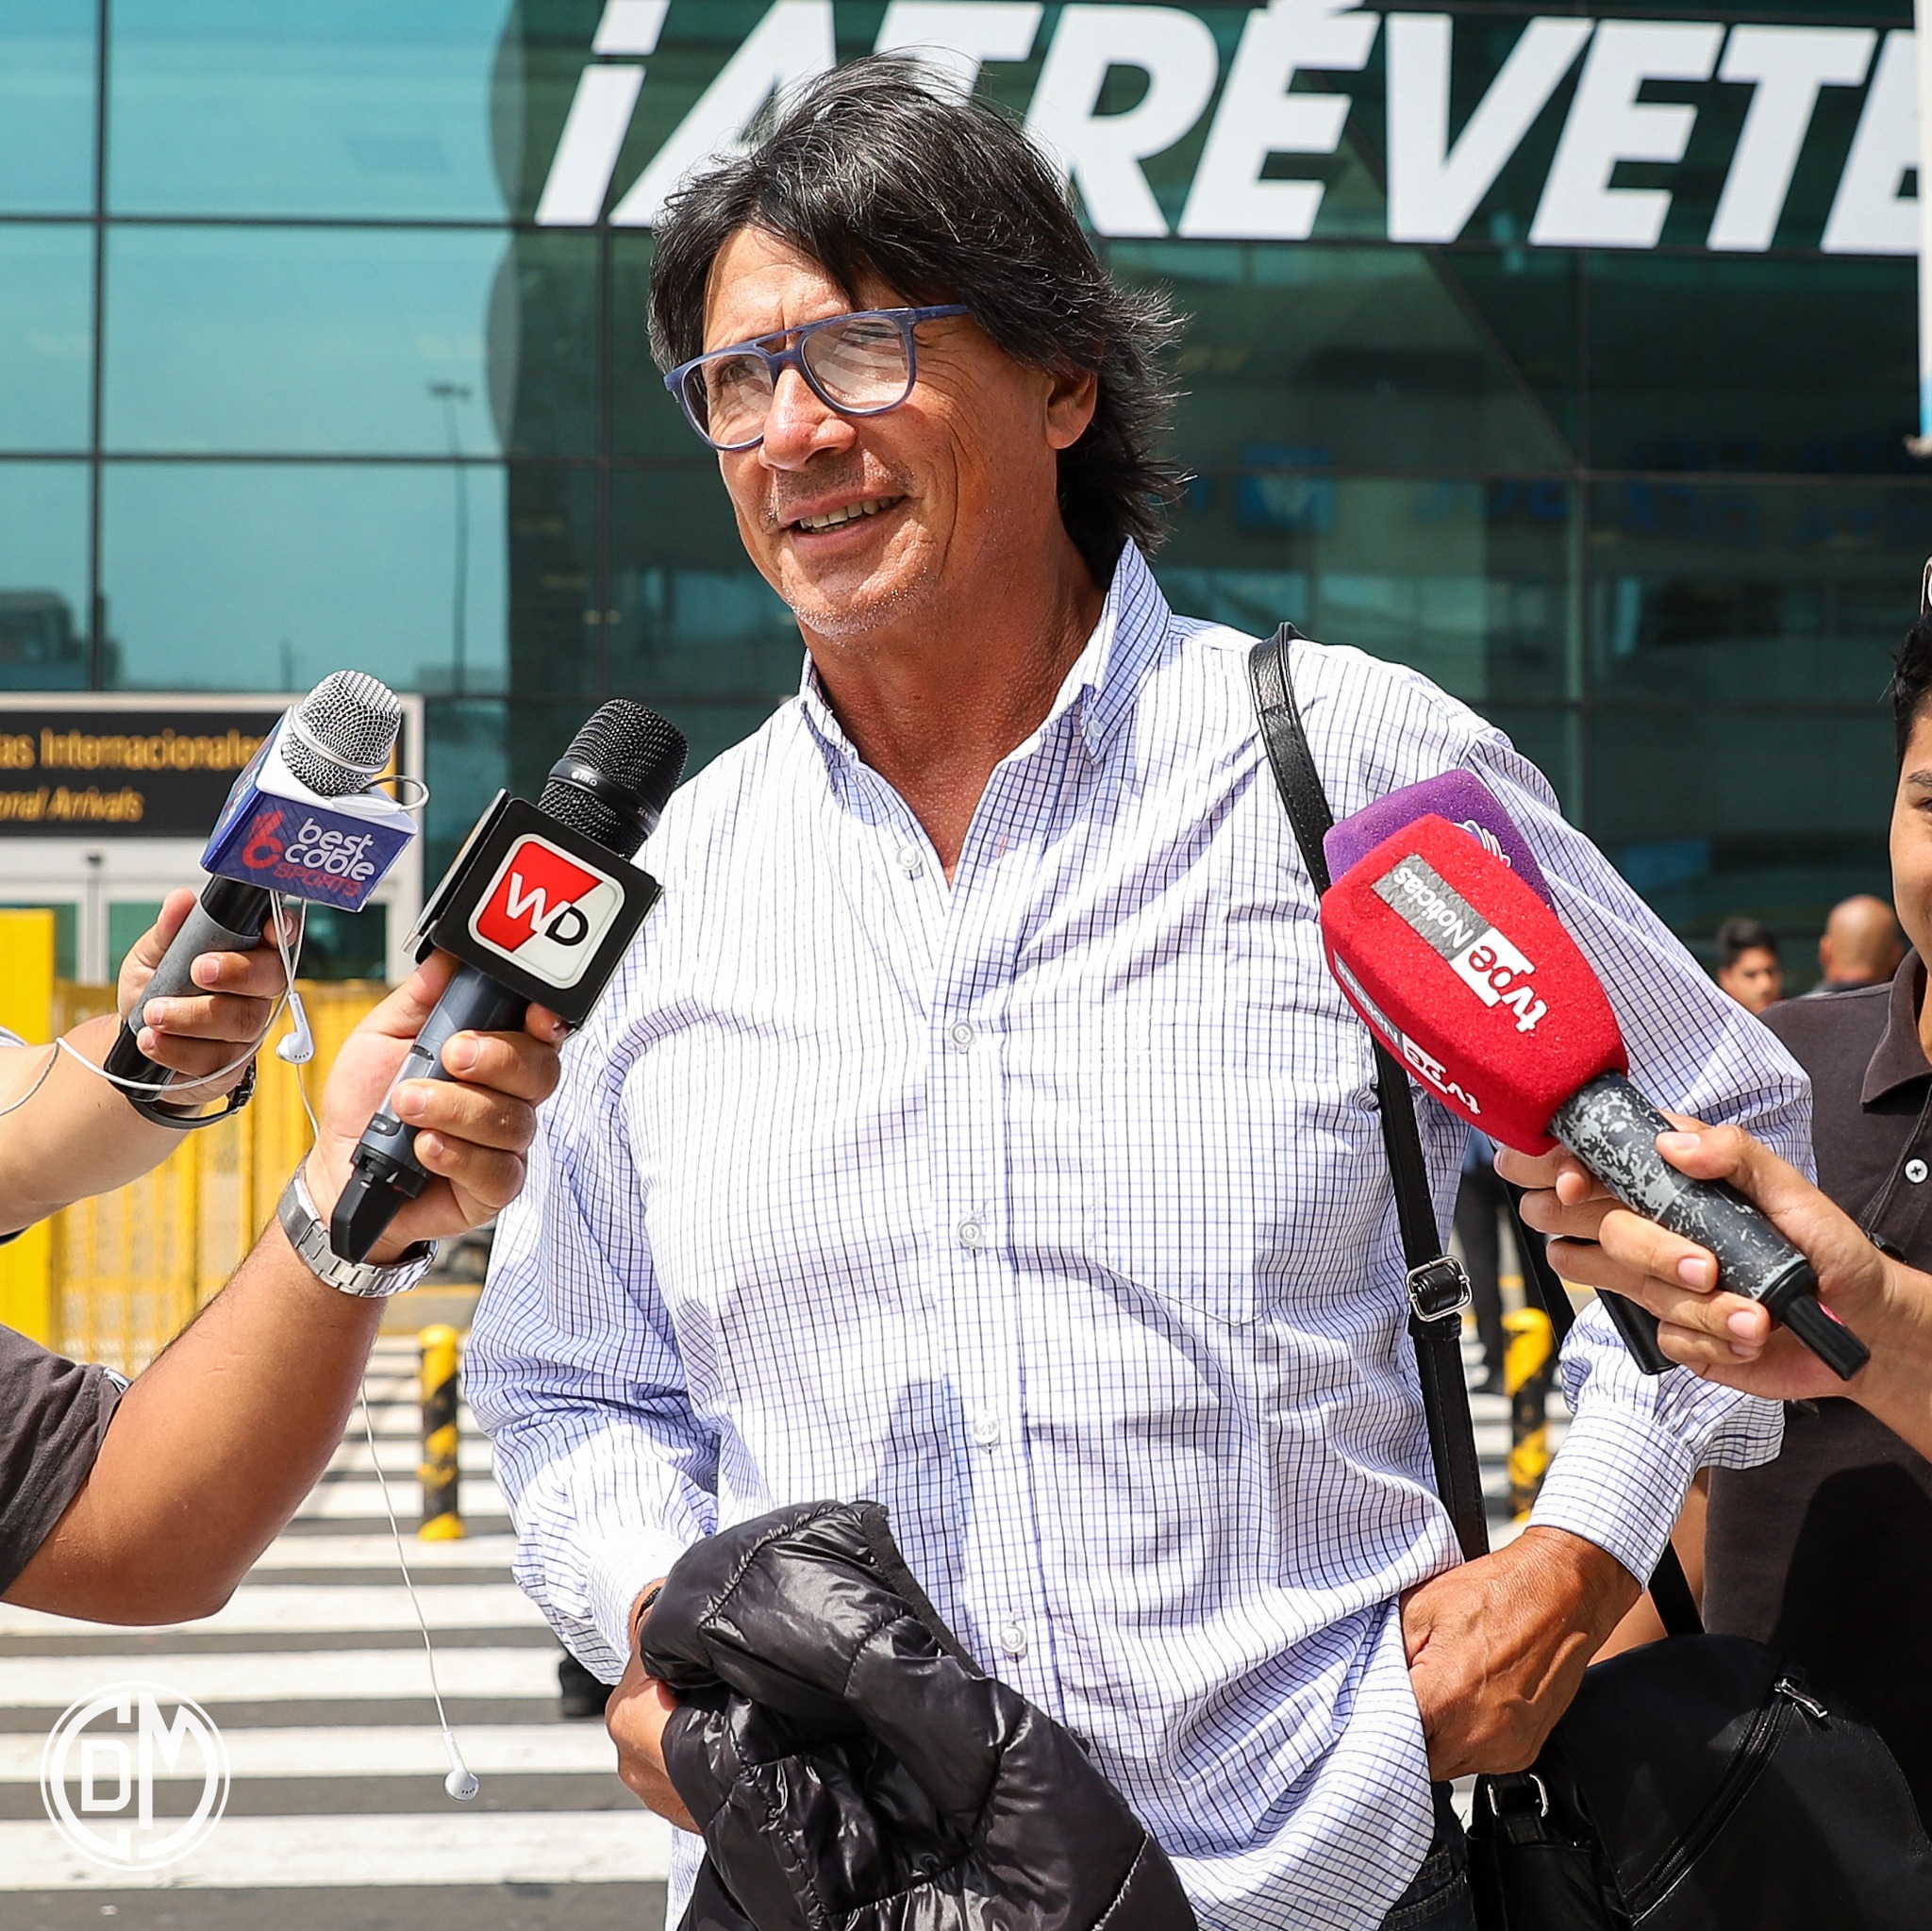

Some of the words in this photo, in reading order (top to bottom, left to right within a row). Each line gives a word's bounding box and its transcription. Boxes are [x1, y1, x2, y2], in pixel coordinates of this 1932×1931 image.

[41, 726, 265, 771] Internacionale
[46, 785, 145, 823] Arrivals
[297, 817, 374, 857] best
[284, 842, 375, 882] cable
[1392, 867, 1474, 949] Noticias
